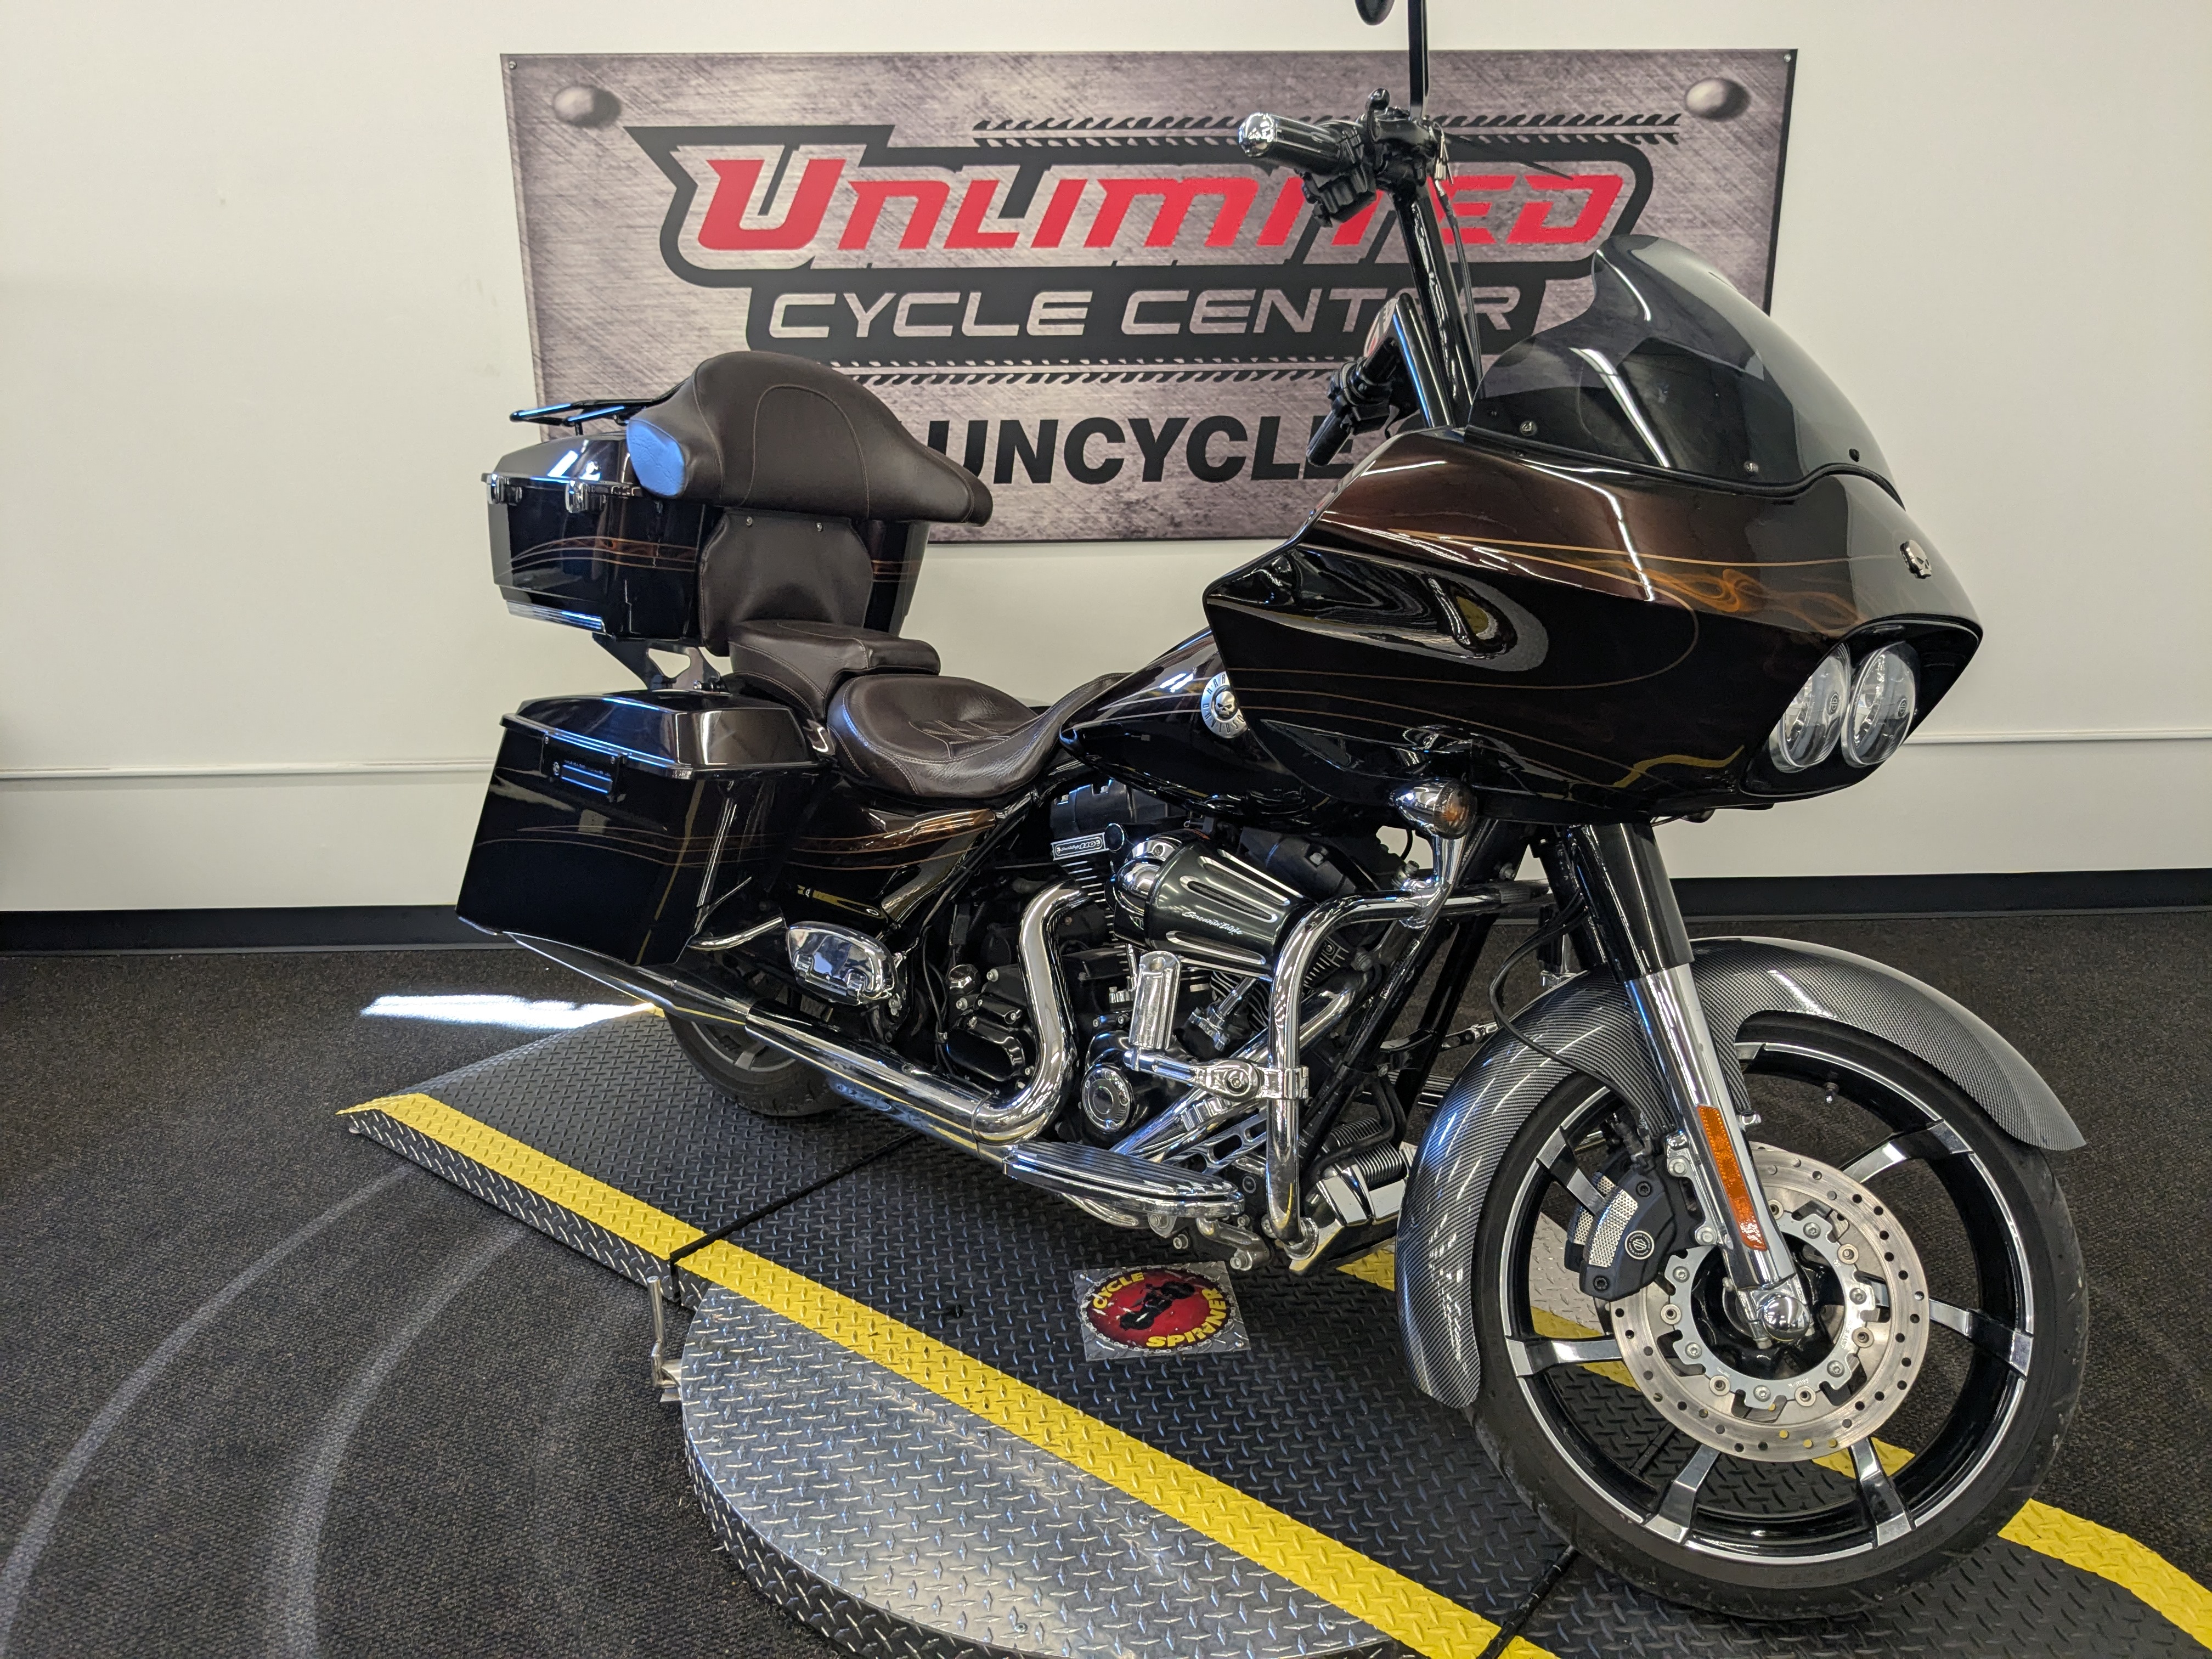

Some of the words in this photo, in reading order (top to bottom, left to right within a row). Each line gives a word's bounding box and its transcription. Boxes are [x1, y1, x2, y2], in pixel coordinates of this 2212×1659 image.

[769, 290, 1092, 339] CYCLE
[1121, 286, 1521, 337] CENTR
[1203, 703, 1245, 733] DAVIDSO
[1093, 1272, 1145, 1309] CYCLE
[1146, 1288, 1227, 1348] SPINNER
